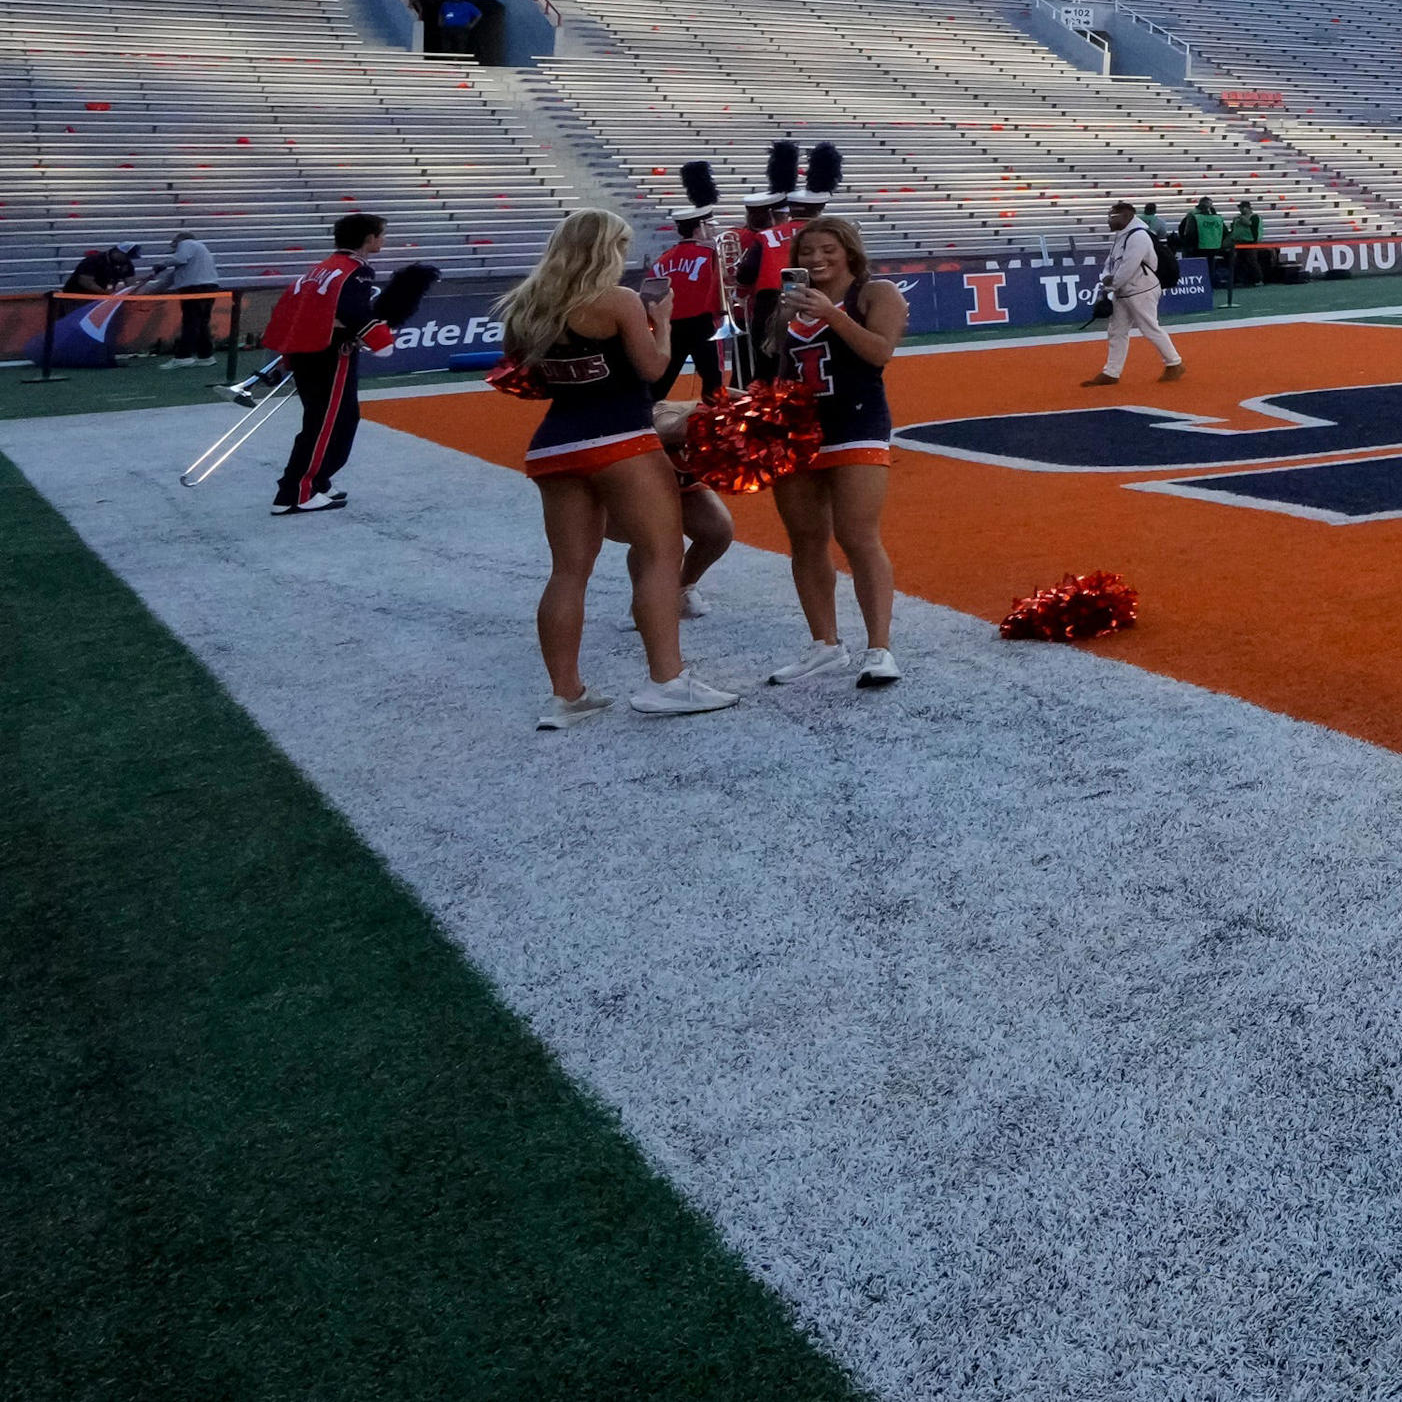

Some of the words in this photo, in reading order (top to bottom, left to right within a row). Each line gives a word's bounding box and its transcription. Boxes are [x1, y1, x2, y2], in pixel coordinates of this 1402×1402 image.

[1073, 8, 1091, 17] 102
[1171, 285, 1205, 297] UNION
[963, 272, 1010, 326] I
